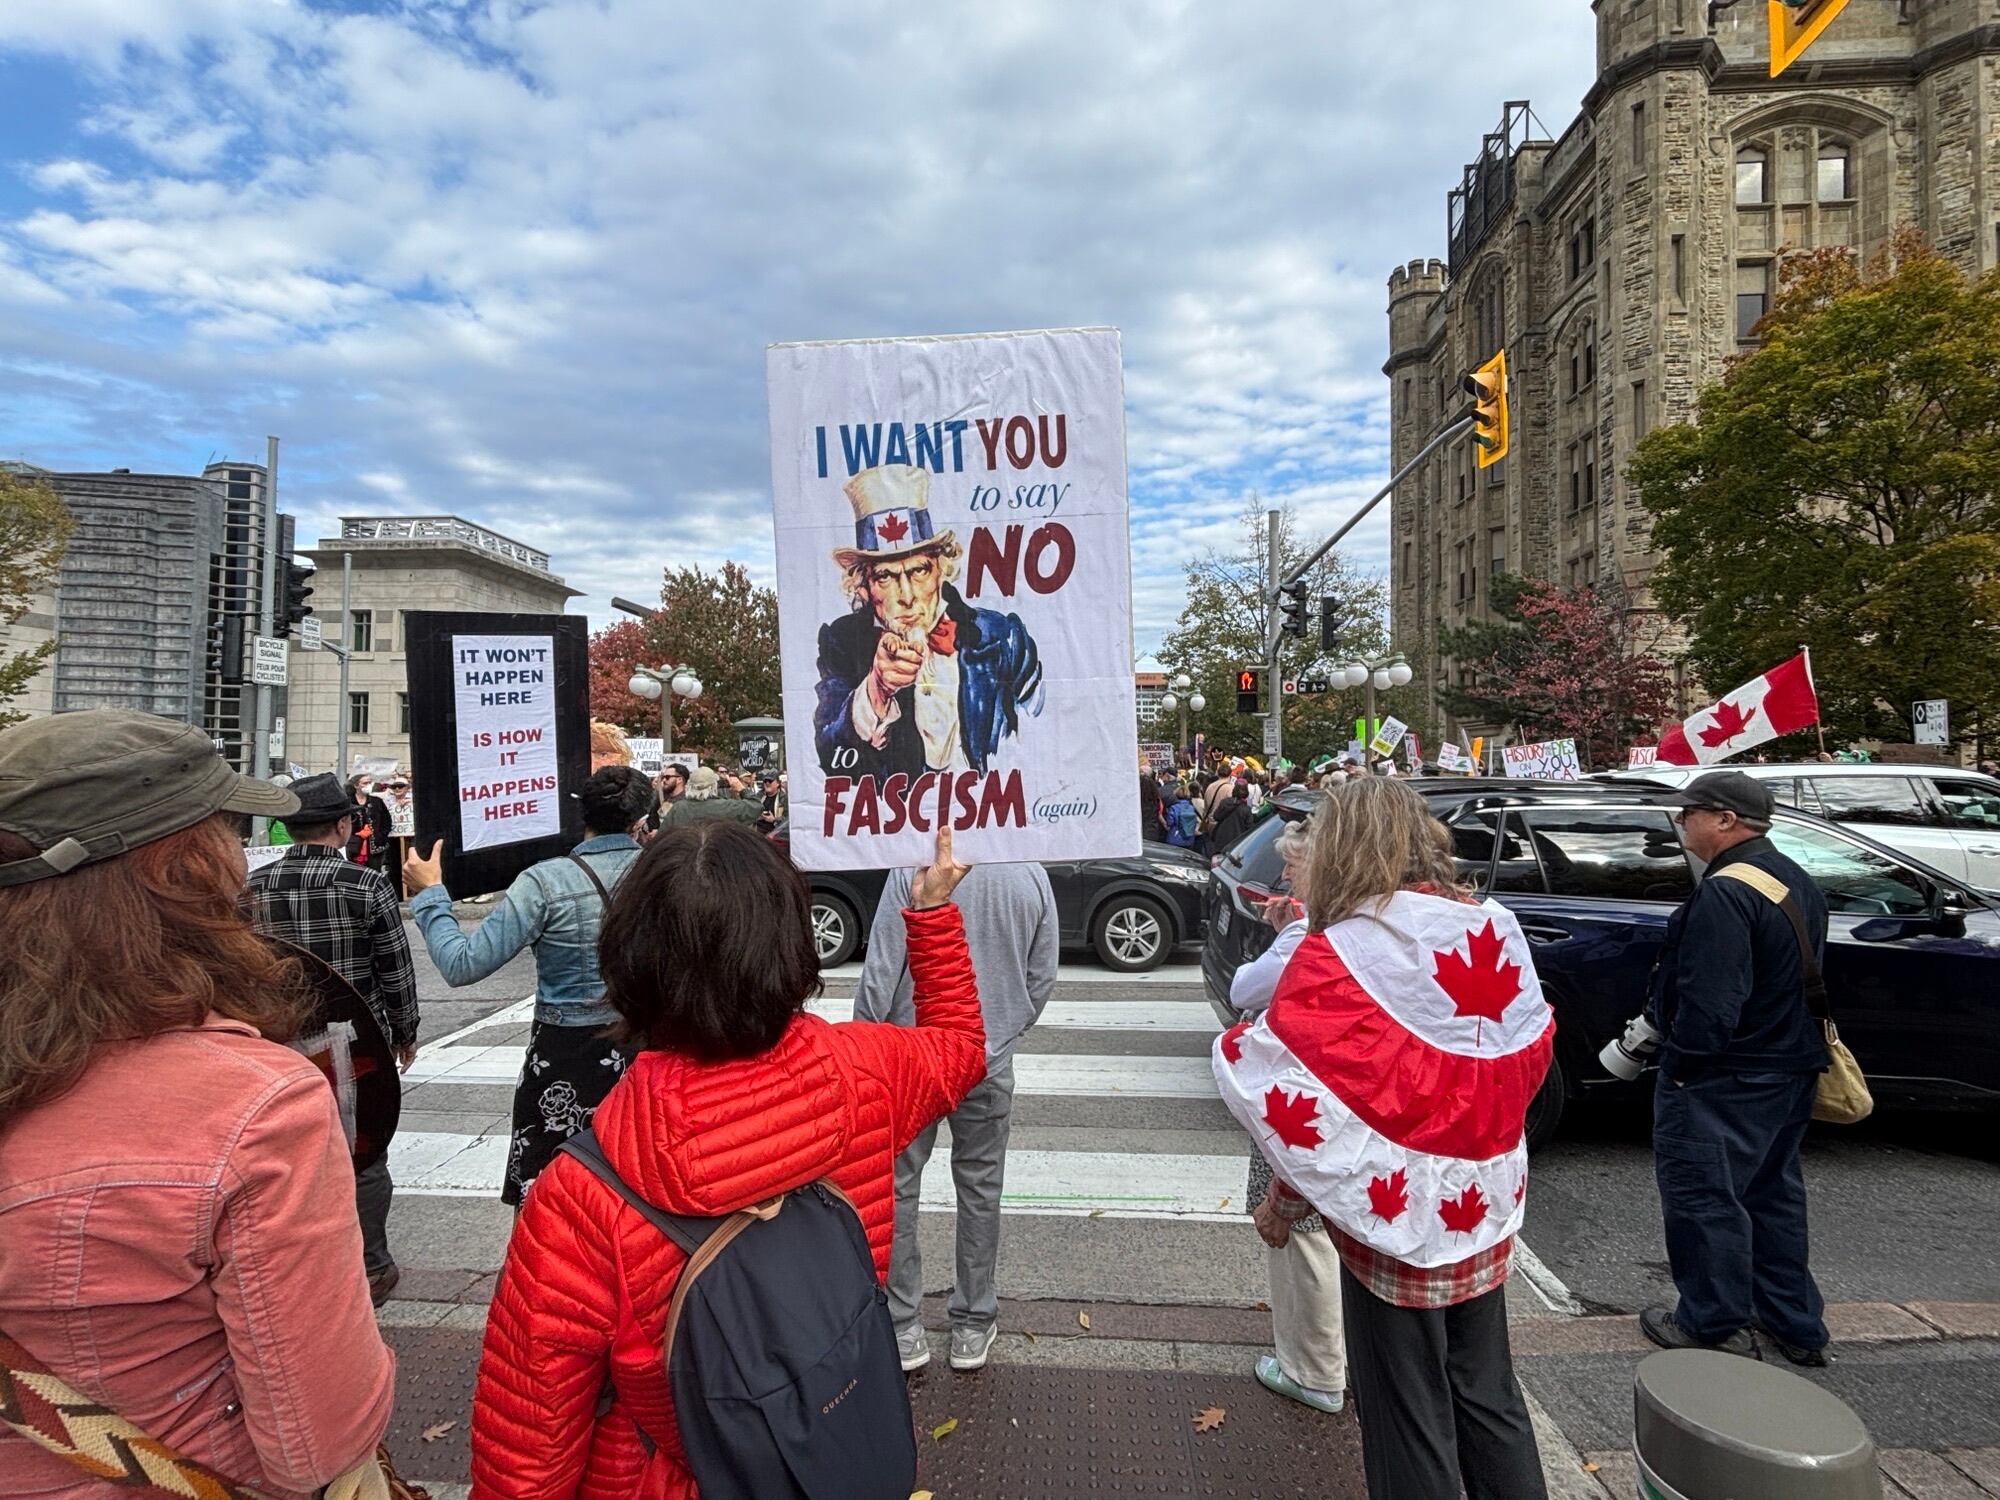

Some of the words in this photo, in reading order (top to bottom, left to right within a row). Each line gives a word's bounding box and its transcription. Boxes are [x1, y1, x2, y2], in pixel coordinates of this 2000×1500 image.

[815, 425, 828, 478] I
[839, 419, 968, 478] WANT
[975, 413, 1067, 471] YOU
[969, 484, 1000, 512] to
[1007, 482, 1071, 519] say
[966, 522, 1076, 599] NO
[259, 640, 284, 650] BICYCLE
[260, 649, 282, 659] SIGNAL
[460, 649, 480, 664] IT
[485, 648, 547, 664] WON'T
[256, 663, 269, 671] FEUX
[271, 664, 285, 673] POUR
[256, 672, 284, 682] CYCLISTES
[466, 669, 544, 686] HAPPEN
[481, 691, 532, 706] HERE
[473, 732, 492, 748] IS
[498, 728, 542, 746] HOW
[500, 751, 518, 766] IT
[831, 746, 858, 769] to
[1504, 743, 1545, 764] HISTORY
[1551, 739, 1576, 756] EYES
[1630, 748, 1655, 766] FASCI
[741, 756, 764, 767] WORLD
[1520, 763, 1532, 771] ON
[1538, 754, 1577, 770] YOU,
[462, 776, 556, 802] HAPPENS
[485, 800, 539, 821] HERE
[824, 768, 1027, 837] FASCISM
[1032, 795, 1098, 823] (again)
